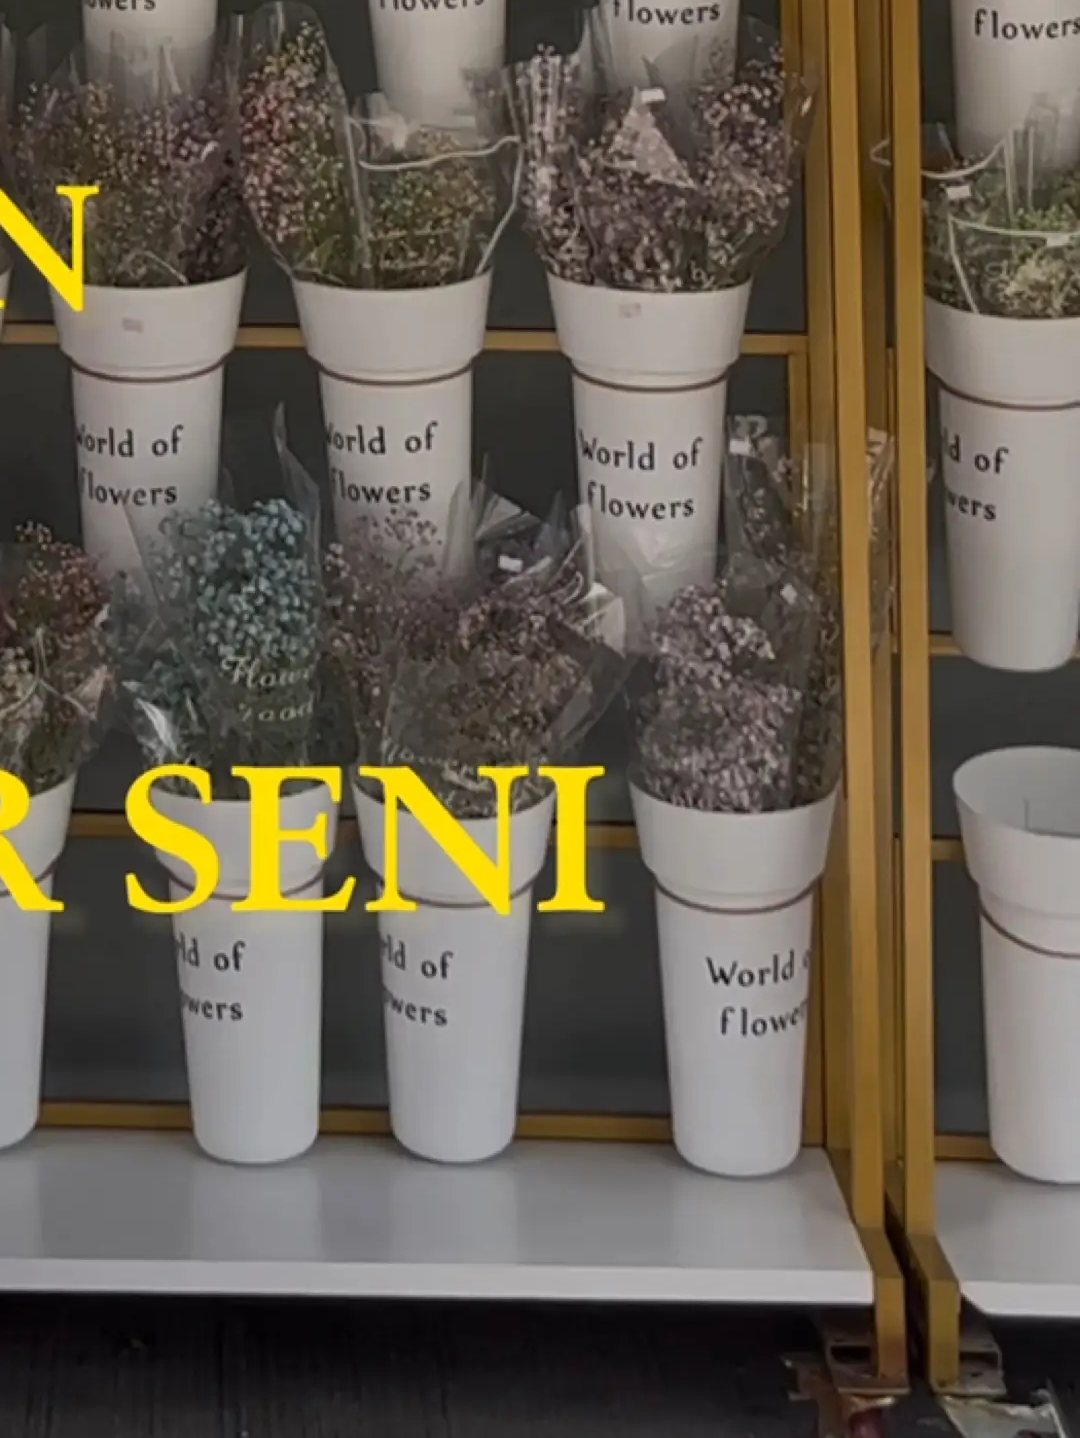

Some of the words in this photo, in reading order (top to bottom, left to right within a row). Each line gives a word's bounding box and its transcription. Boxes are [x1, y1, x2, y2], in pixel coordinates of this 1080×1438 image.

[974, 8, 1080, 40] flowers
[151, 424, 184, 457] of
[404, 420, 439, 453] of
[577, 431, 655, 471] World
[673, 437, 703, 470] of
[974, 446, 1009, 474] of
[587, 480, 694, 520] flowers
[214, 940, 246, 972] of
[421, 950, 454, 979] of
[706, 948, 795, 988] World
